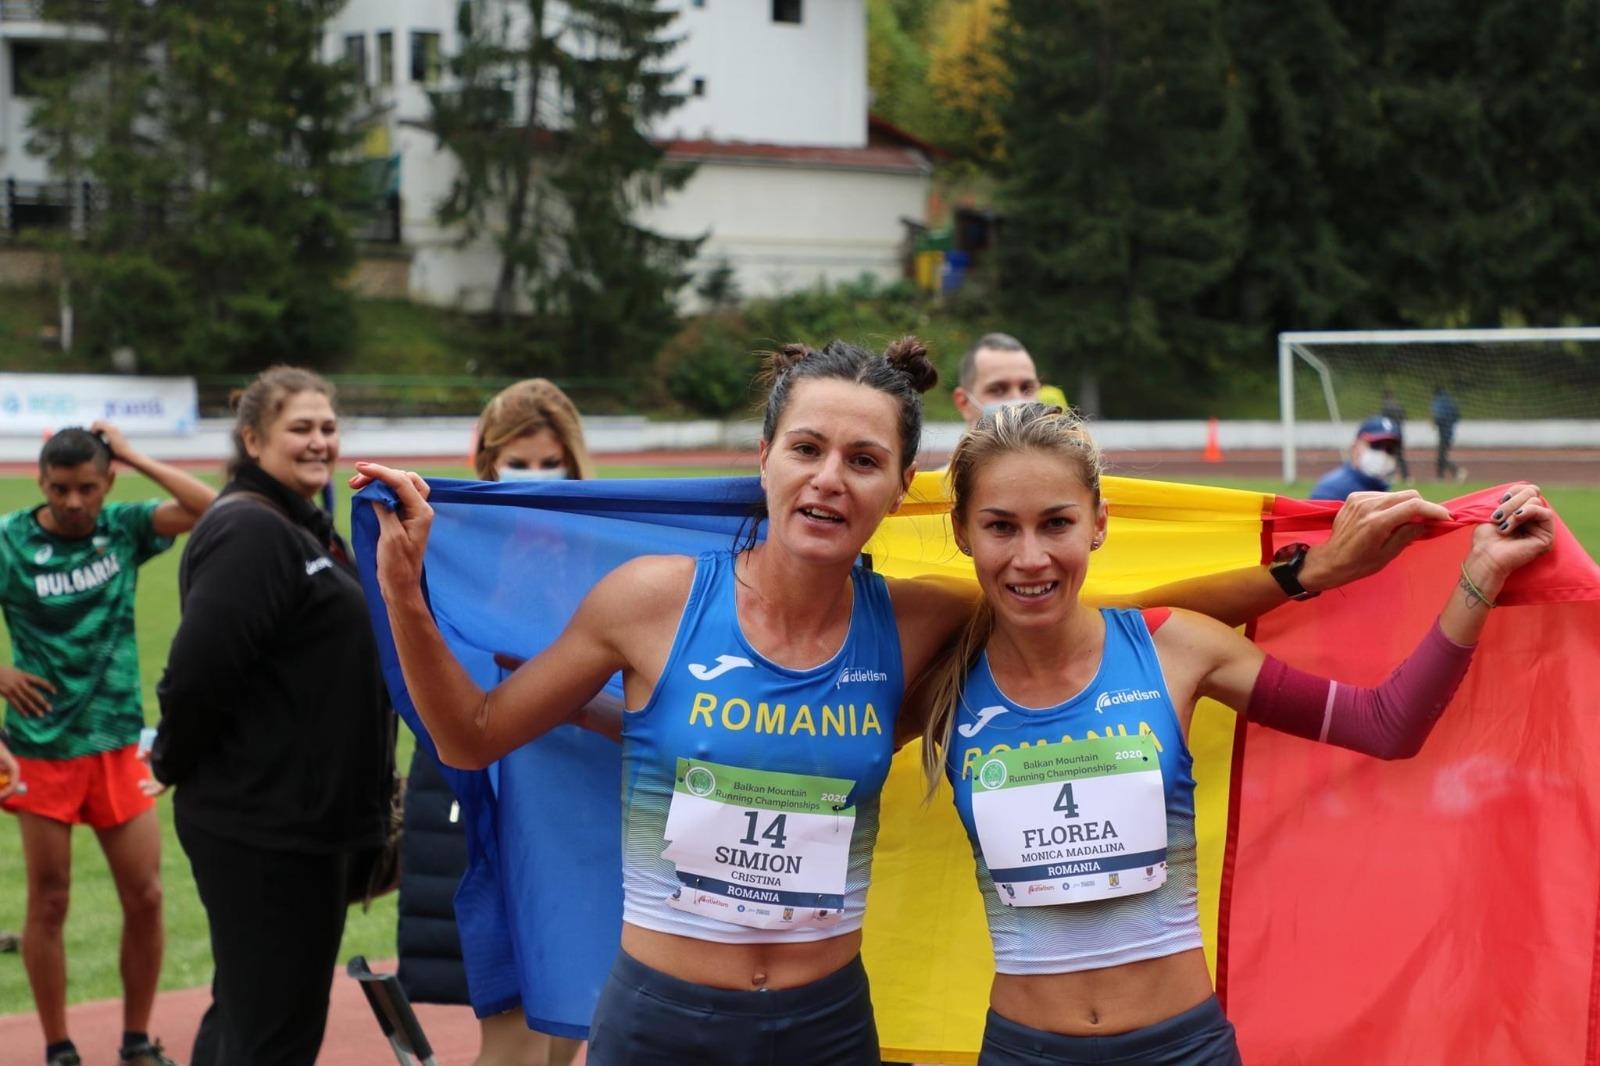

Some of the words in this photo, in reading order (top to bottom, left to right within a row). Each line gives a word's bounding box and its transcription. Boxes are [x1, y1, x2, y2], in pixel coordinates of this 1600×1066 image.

[849, 669, 888, 682] atletism
[1111, 688, 1161, 706] atletism
[689, 692, 882, 737] ROMANIA
[1023, 758, 1054, 770] Balkan
[1055, 753, 1099, 767] Mountain
[1115, 750, 1143, 761] 2020
[1008, 771, 1045, 784] Running
[1046, 762, 1118, 779] Championships
[733, 781, 766, 795] Balkan
[767, 784, 807, 798] Mountain
[820, 792, 847, 803] 2020
[715, 788, 753, 804] Running
[754, 796, 821, 811] Championships
[1053, 782, 1080, 819] 4
[739, 811, 787, 849] 14
[1023, 820, 1118, 849] FLOREA
[714, 846, 803, 874] SIMION
[1021, 849, 1065, 863] MONICA
[1066, 842, 1126, 858] MADALINA
[1047, 861, 1101, 877] ROMANIA
[731, 870, 782, 887] CRISTINA
[727, 885, 780, 903] ROMANIA
